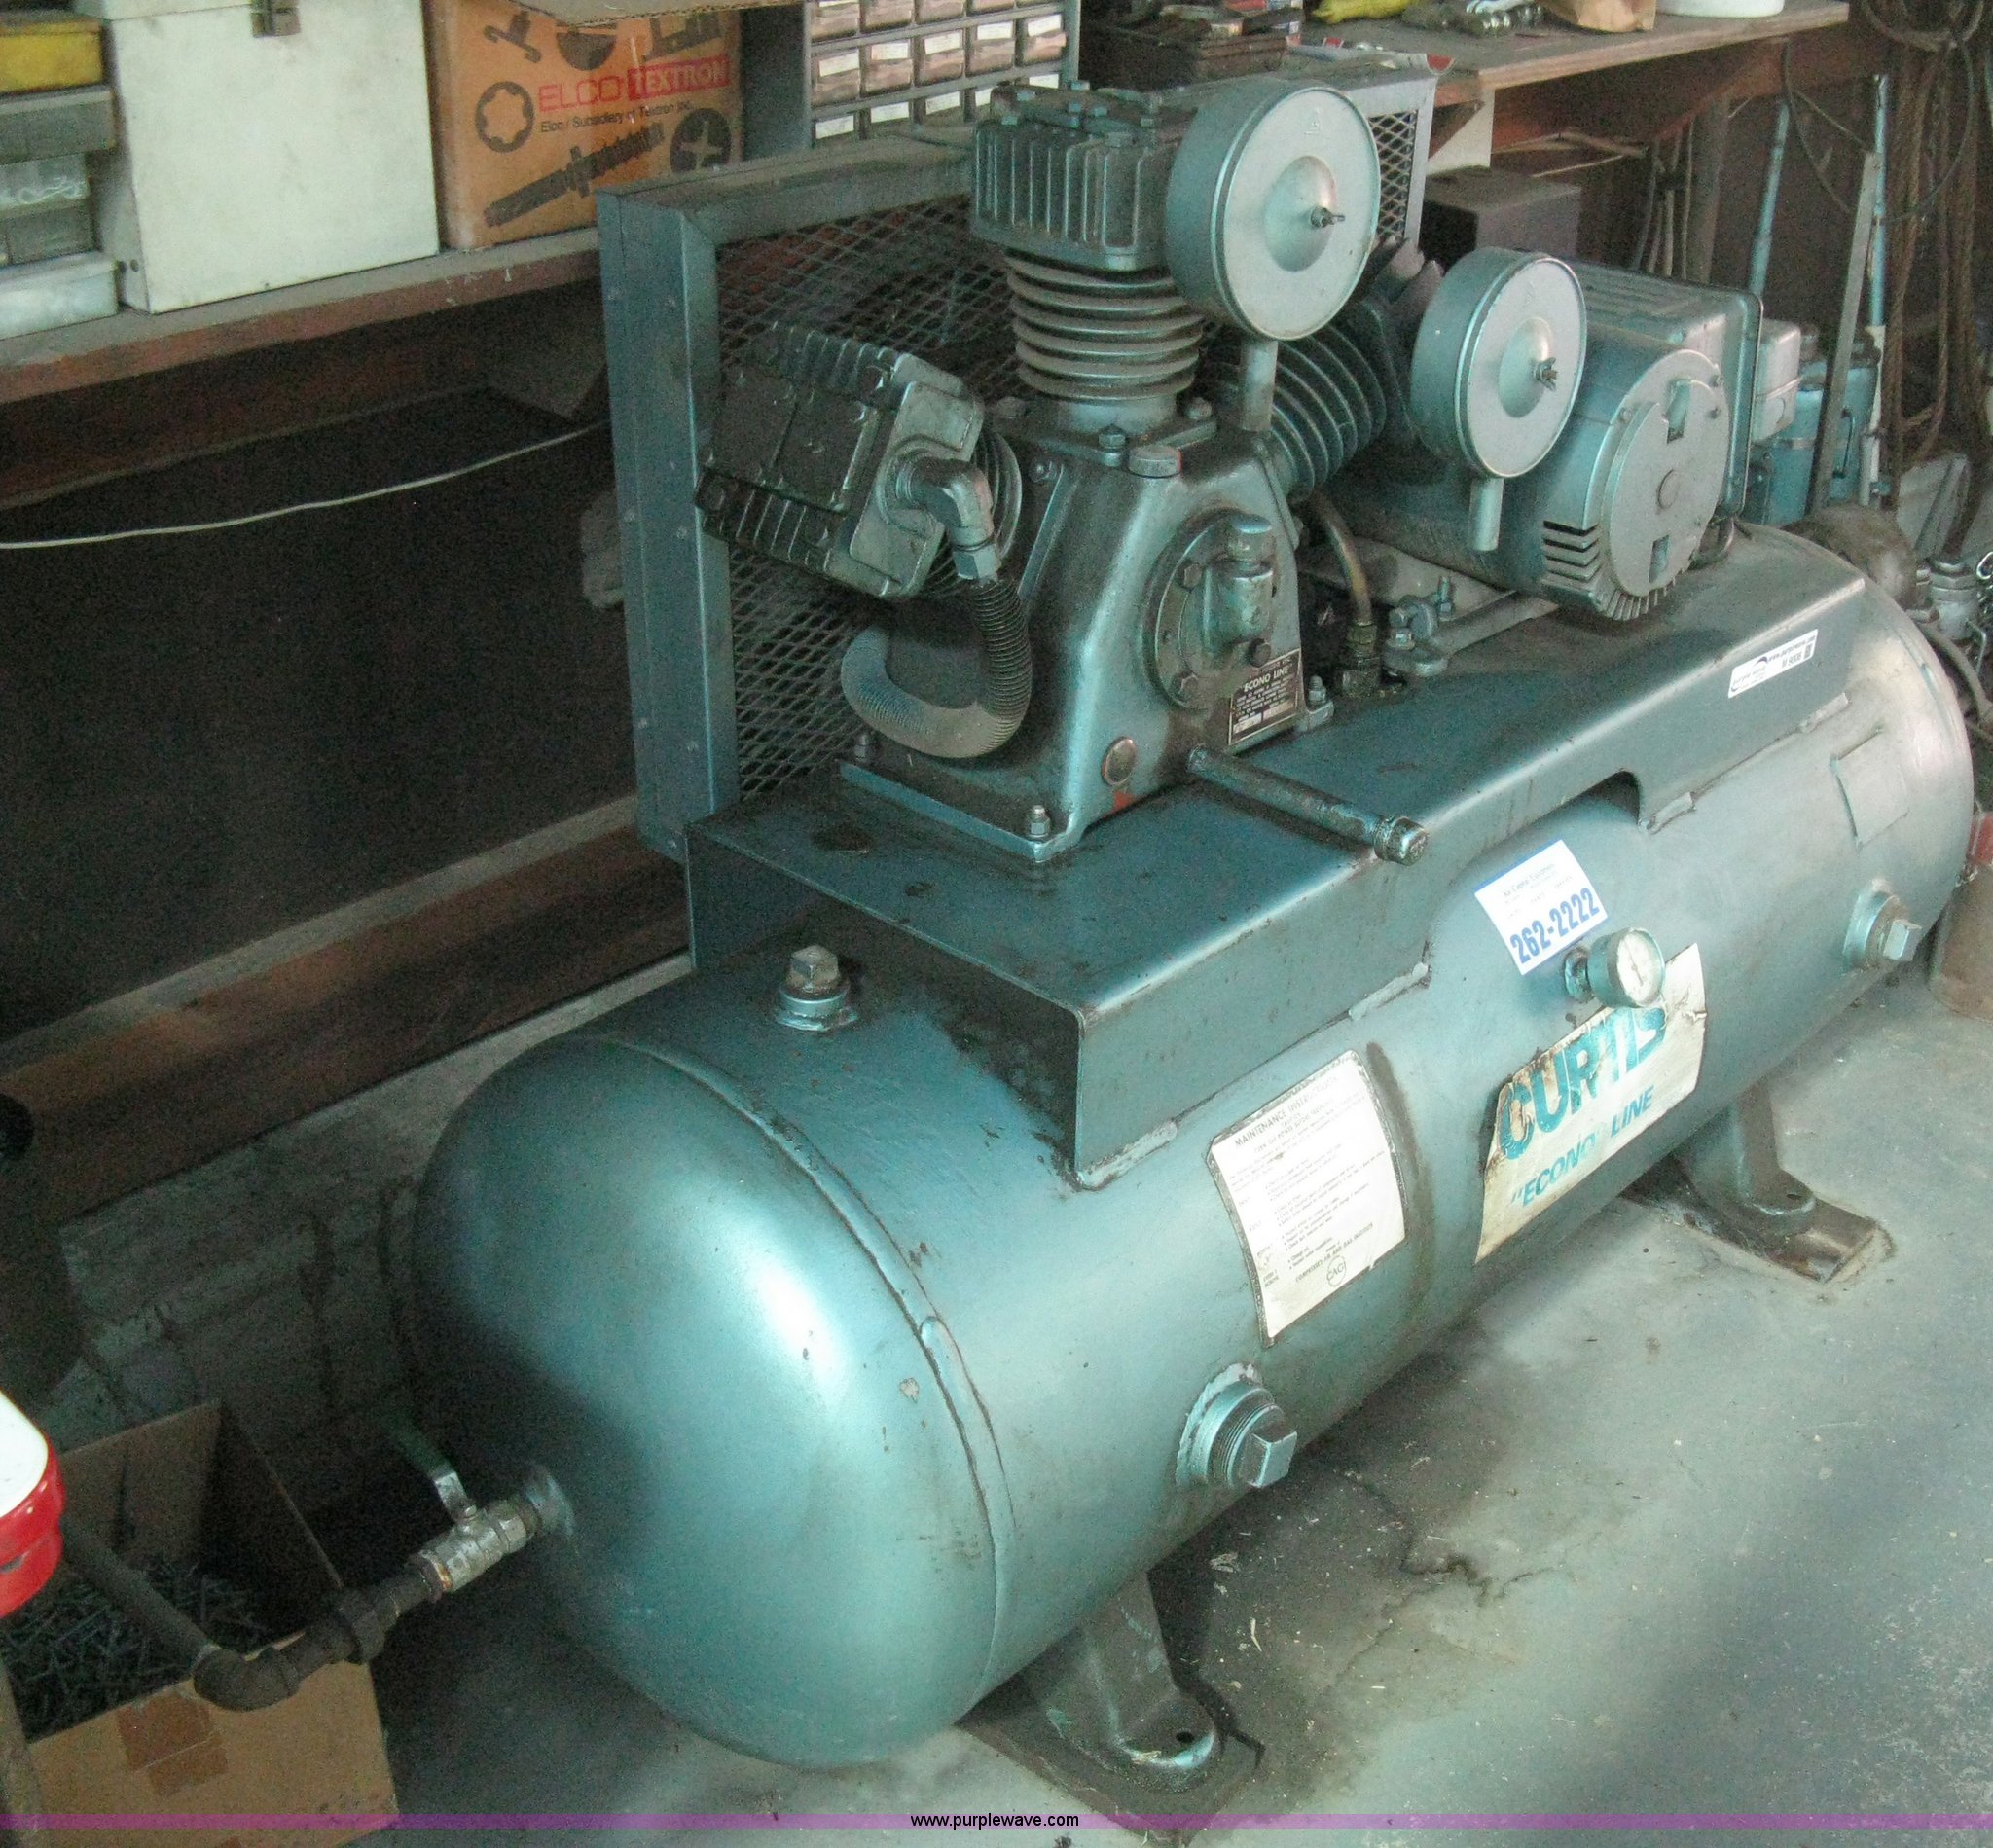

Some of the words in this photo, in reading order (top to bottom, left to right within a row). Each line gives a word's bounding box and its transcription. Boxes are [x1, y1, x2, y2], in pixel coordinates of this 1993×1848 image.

[538, 76, 622, 112] ELCO
[633, 59, 728, 98] TEXTRON
[1509, 887, 1600, 965] 262-2222
[1500, 1006, 1667, 1160] CURTIS
[1234, 1108, 1286, 1146] MAINTENANCE
[1611, 1085, 1654, 1138] LINE
